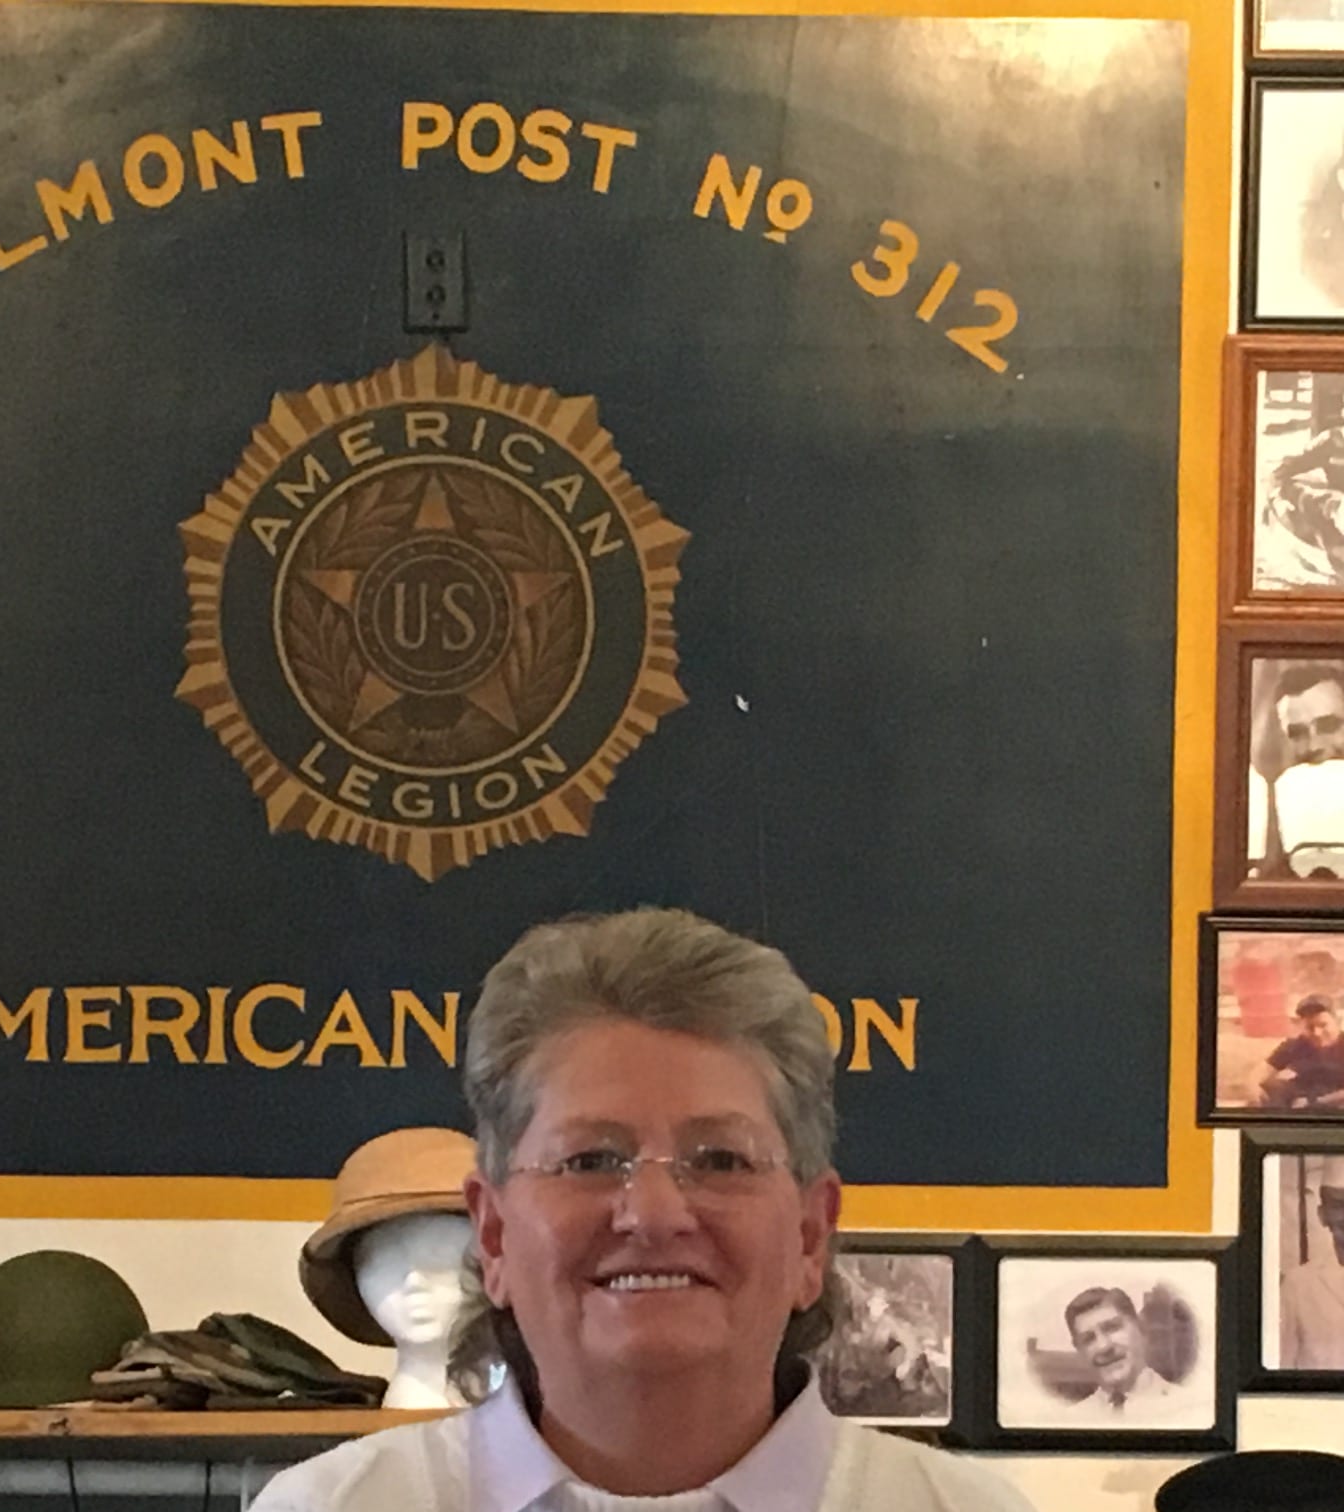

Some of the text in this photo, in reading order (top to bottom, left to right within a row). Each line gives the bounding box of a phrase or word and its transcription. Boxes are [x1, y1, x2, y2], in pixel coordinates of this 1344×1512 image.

[401, 102, 637, 193] POST
[851, 220, 1019, 373] 312
[251, 411, 624, 556] AMERICAN
[299, 740, 567, 819] LEGION
